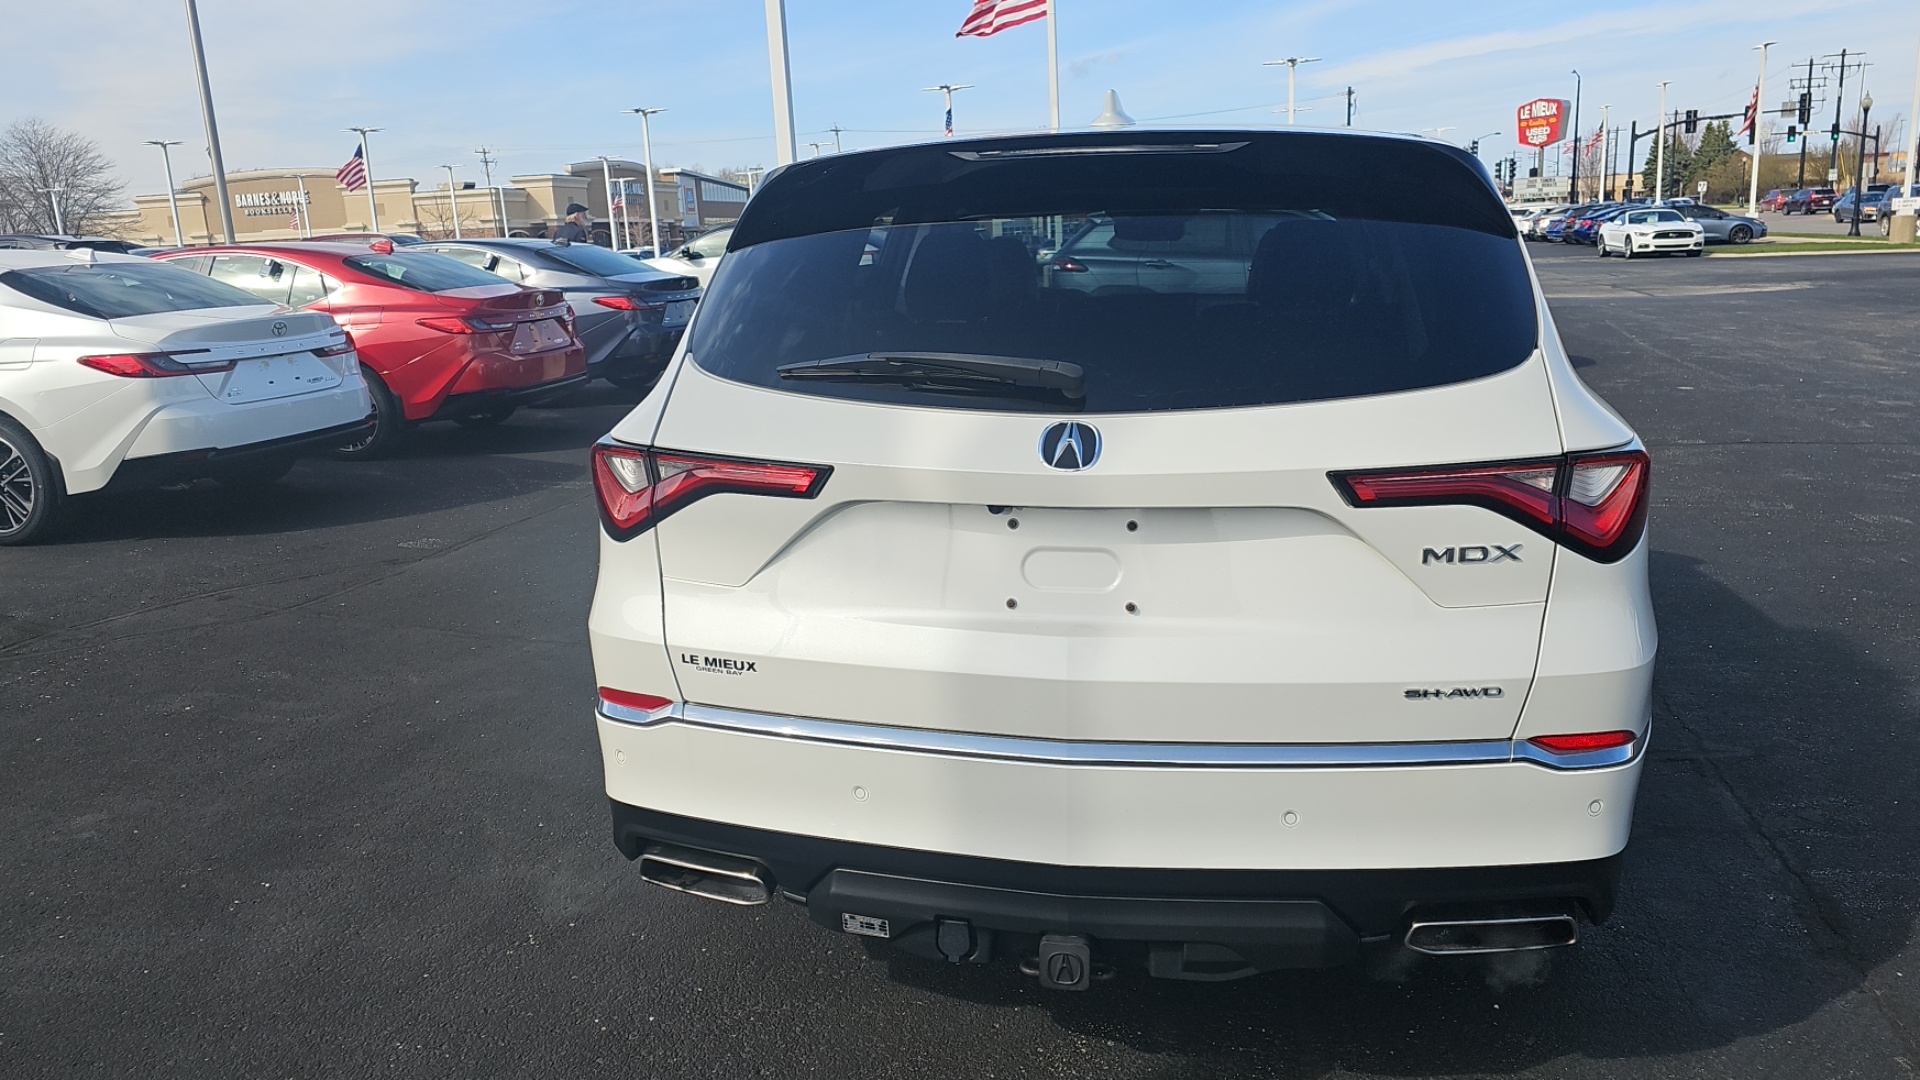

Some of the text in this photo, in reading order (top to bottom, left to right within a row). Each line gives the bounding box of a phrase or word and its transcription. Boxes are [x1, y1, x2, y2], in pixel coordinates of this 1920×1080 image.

[1520, 101, 1558, 120] LE MIEUX
[1526, 126, 1551, 136] USED
[1528, 134, 1548, 144] CARS
[1421, 544, 1524, 565] MDX
[681, 653, 758, 673] LE MIEUX
[695, 666, 724, 674] GREEN
